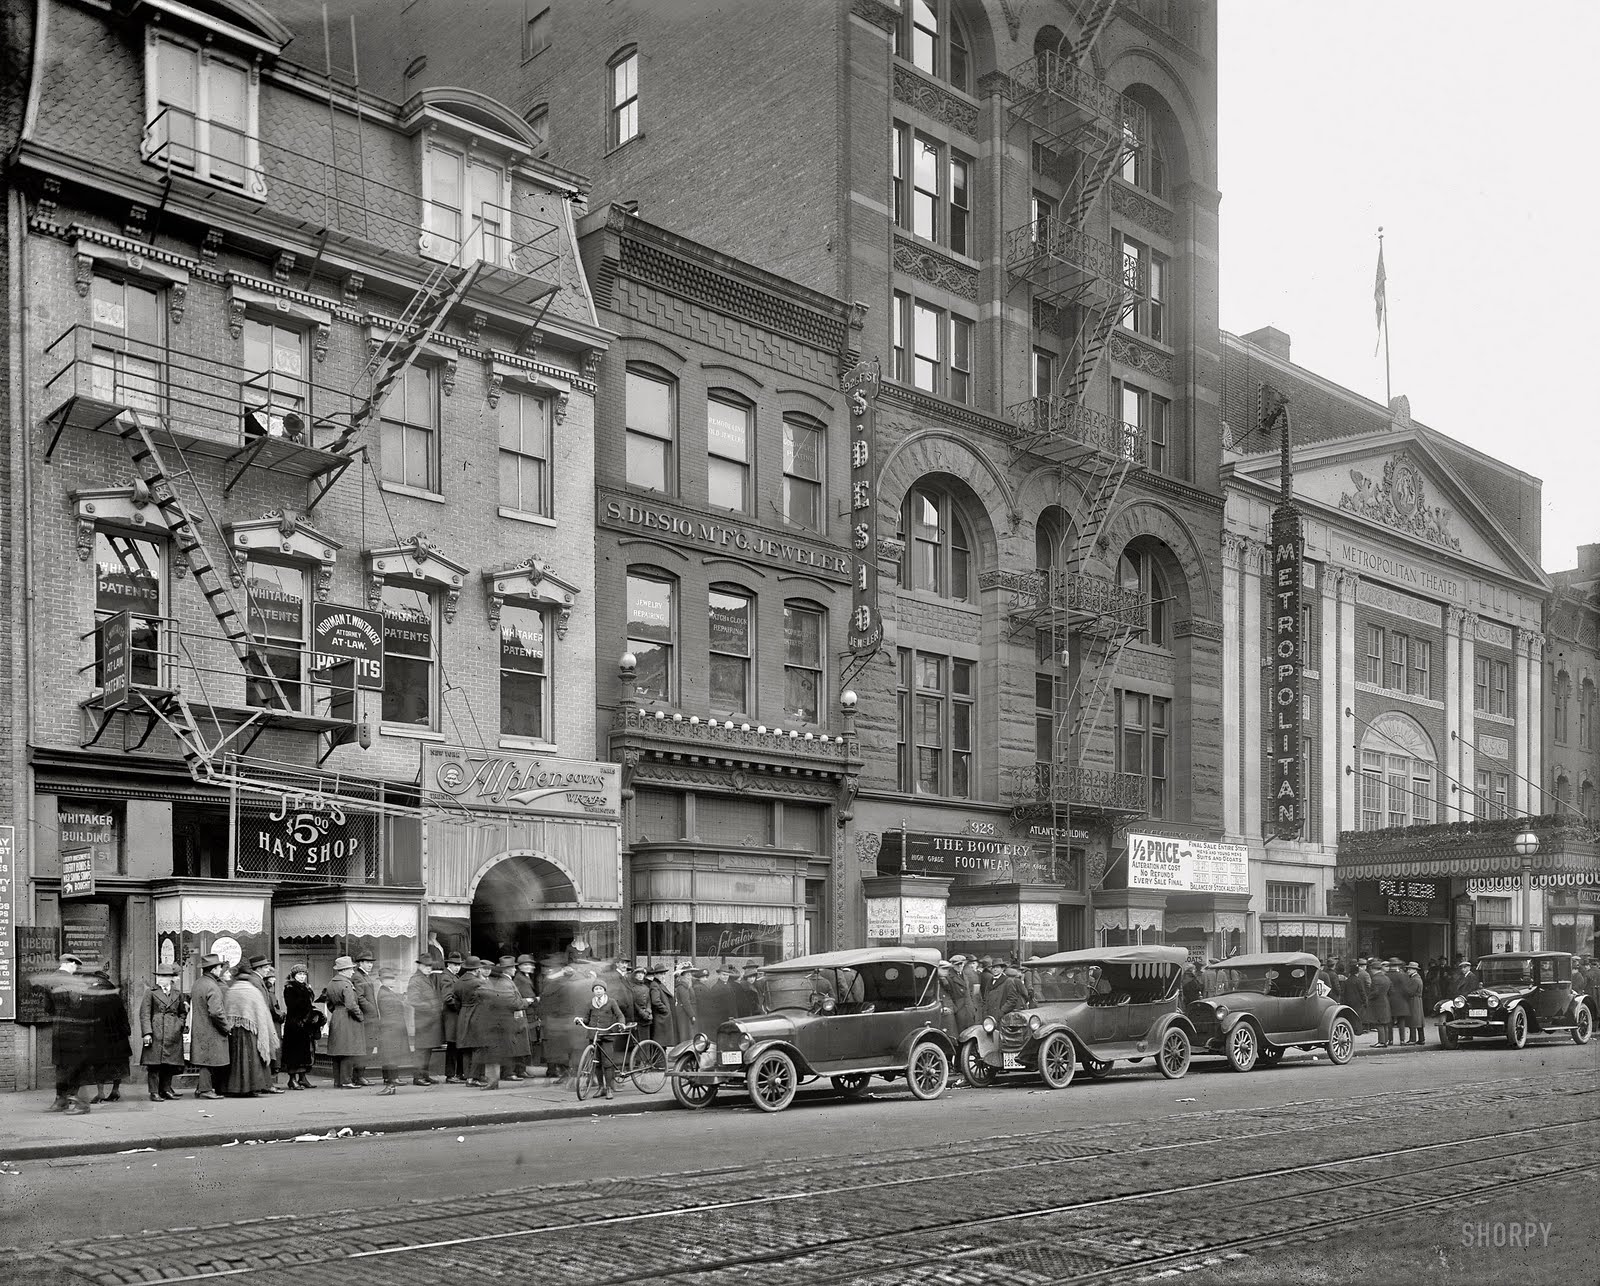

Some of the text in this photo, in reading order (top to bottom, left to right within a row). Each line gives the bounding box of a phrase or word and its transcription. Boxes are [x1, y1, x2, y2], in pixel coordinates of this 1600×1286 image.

[606, 501, 625, 521] S.
[627, 506, 696, 540] DESIO,
[753, 537, 850, 575] JEWELER.
[1341, 543, 1458, 597] METROPOLITAN THEATER
[99, 581, 158, 600] PATENTS
[249, 587, 302, 605] WHITAKER
[635, 599, 663, 610] JEWELRY
[250, 606, 300, 624] PATENTS
[633, 609, 665, 621] REPAIRING
[316, 614, 345, 636] NORMAN
[351, 615, 382, 646] WHITAKER
[336, 628, 362, 639] ATTORNEY
[384, 627, 430, 643] PATENTS
[501, 626, 544, 643] WHITAKER
[713, 624, 744, 636] REPAIRING
[503, 644, 544, 659] PATENTS
[105, 673, 126, 697] PATENTS
[1275, 543, 1295, 822] METROPOLITAN
[565, 792, 608, 807] WRAPS
[58, 812, 114, 826] WHITAKER
[971, 822, 995, 835] 928
[62, 830, 111, 843] BUILDING
[259, 831, 358, 864] HAT SHOP
[933, 838, 1030, 857] THE BOOTERY
[1147, 840, 1180, 864] PRICE
[1218, 843, 1234, 851] ENTIRE
[1235, 844, 1247, 852] STOCK
[911, 854, 924, 862] HIGH
[955, 856, 1011, 871] FOOTWEAR
[1132, 861, 1160, 870] ALTERATION
[1133, 876, 1183, 886] EVERY SALE FINAL
[1140, 869, 1174, 878] NO REFUNDS
[1190, 882, 1208, 891] BALANCE
[1213, 883, 1226, 892] STOCK
[1380, 880, 1406, 896] POLA
[21, 937, 56, 950] LIBERTY
[21, 952, 56, 964] BONDS
